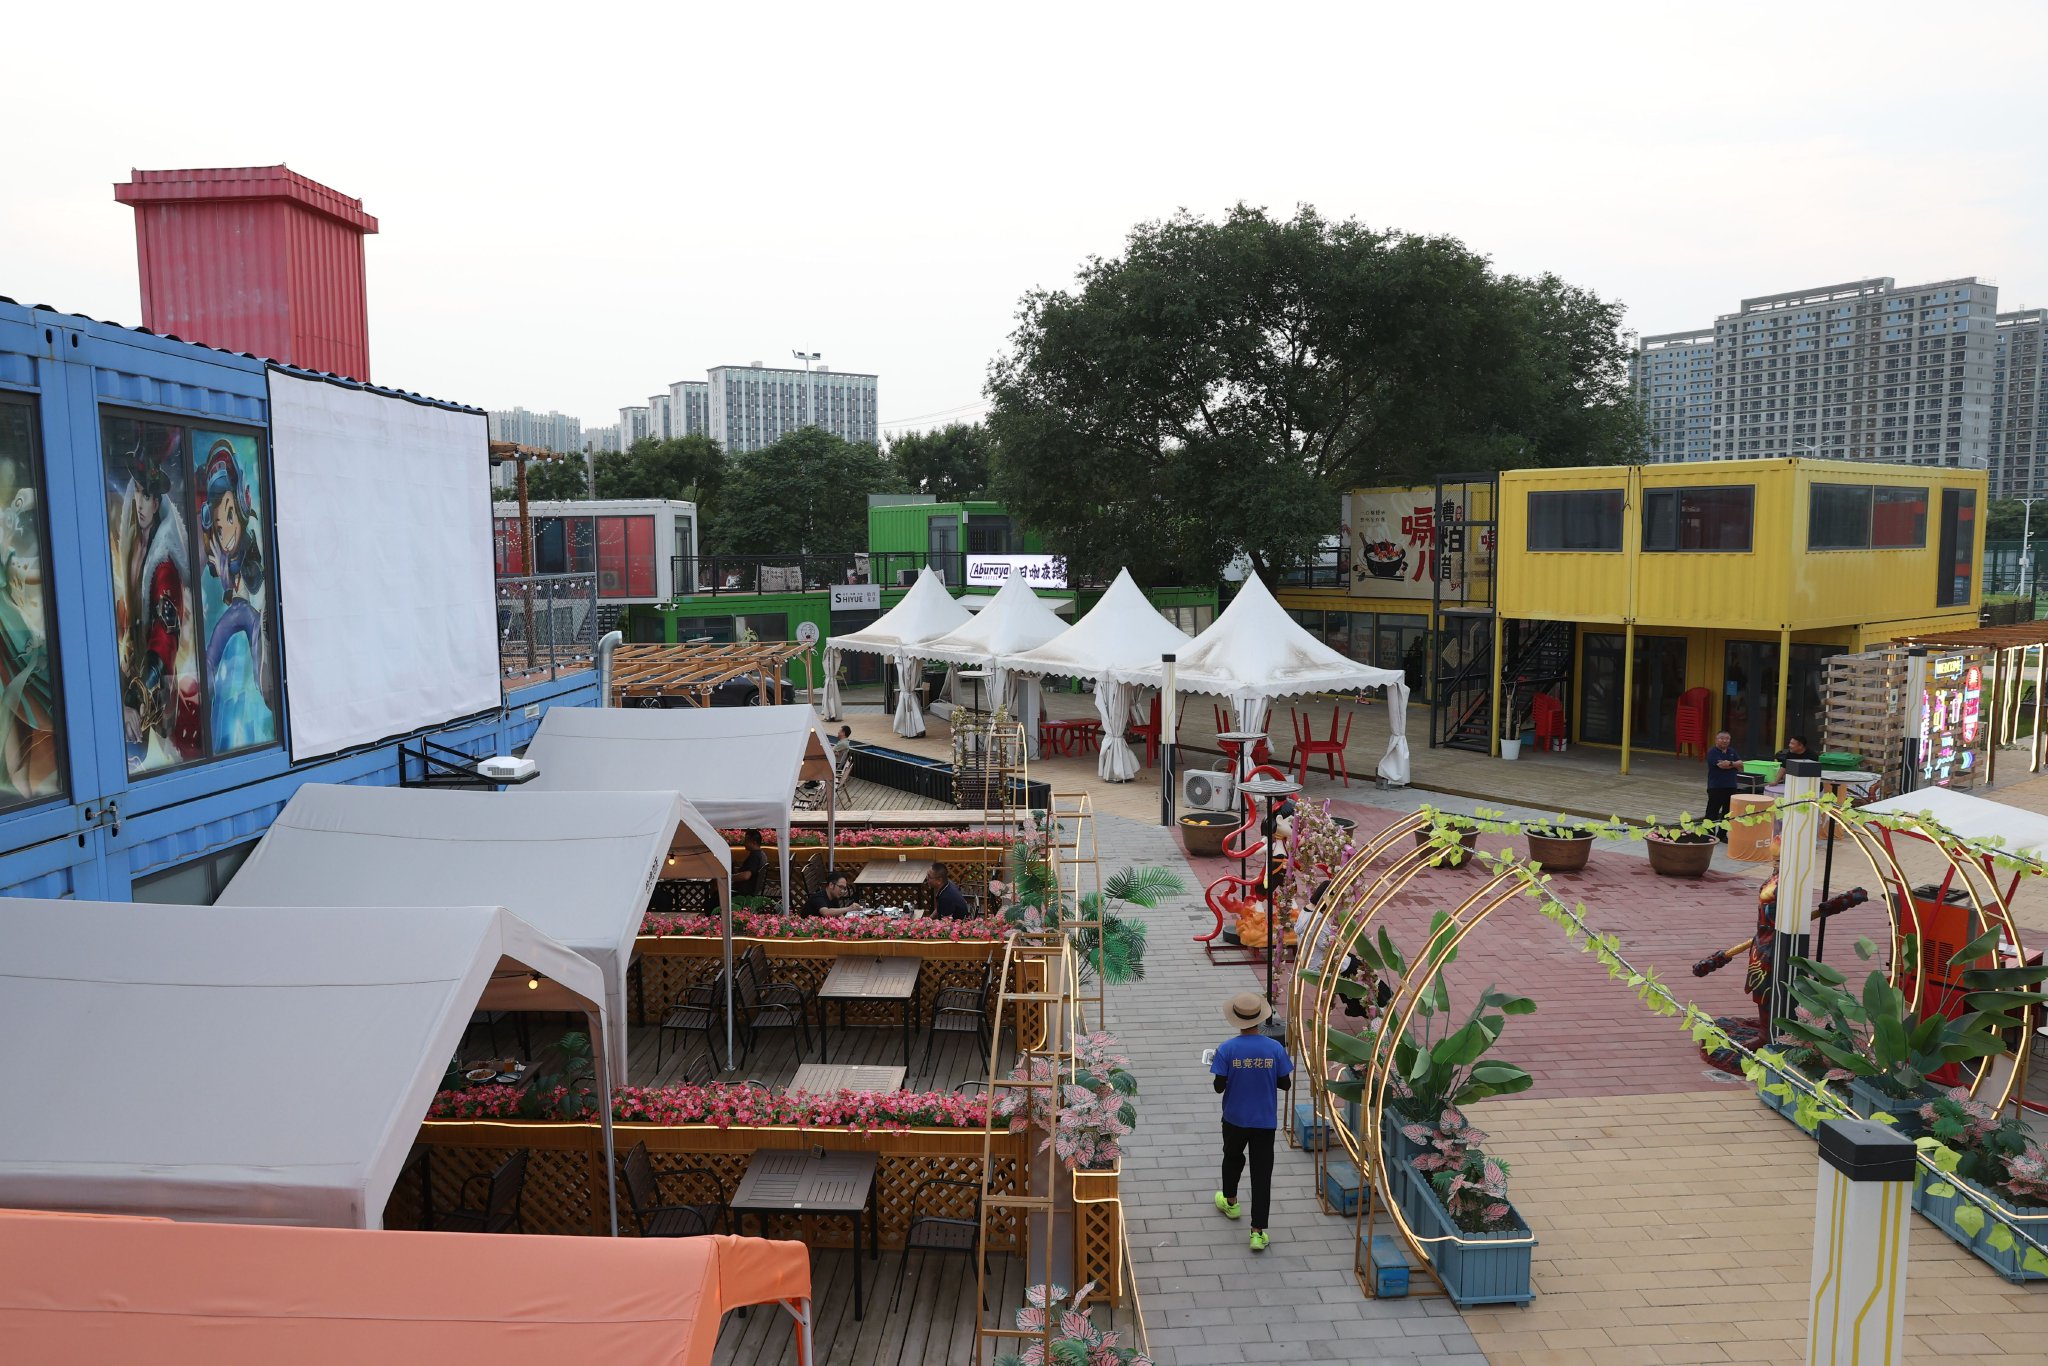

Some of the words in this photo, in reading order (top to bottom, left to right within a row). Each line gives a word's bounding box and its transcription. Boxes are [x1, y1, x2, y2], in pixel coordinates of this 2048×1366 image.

[973, 563, 1009, 578] Aburaya
[835, 593, 863, 603] SHIYUE
[1232, 1058, 1274, 1069] 电竞花园
